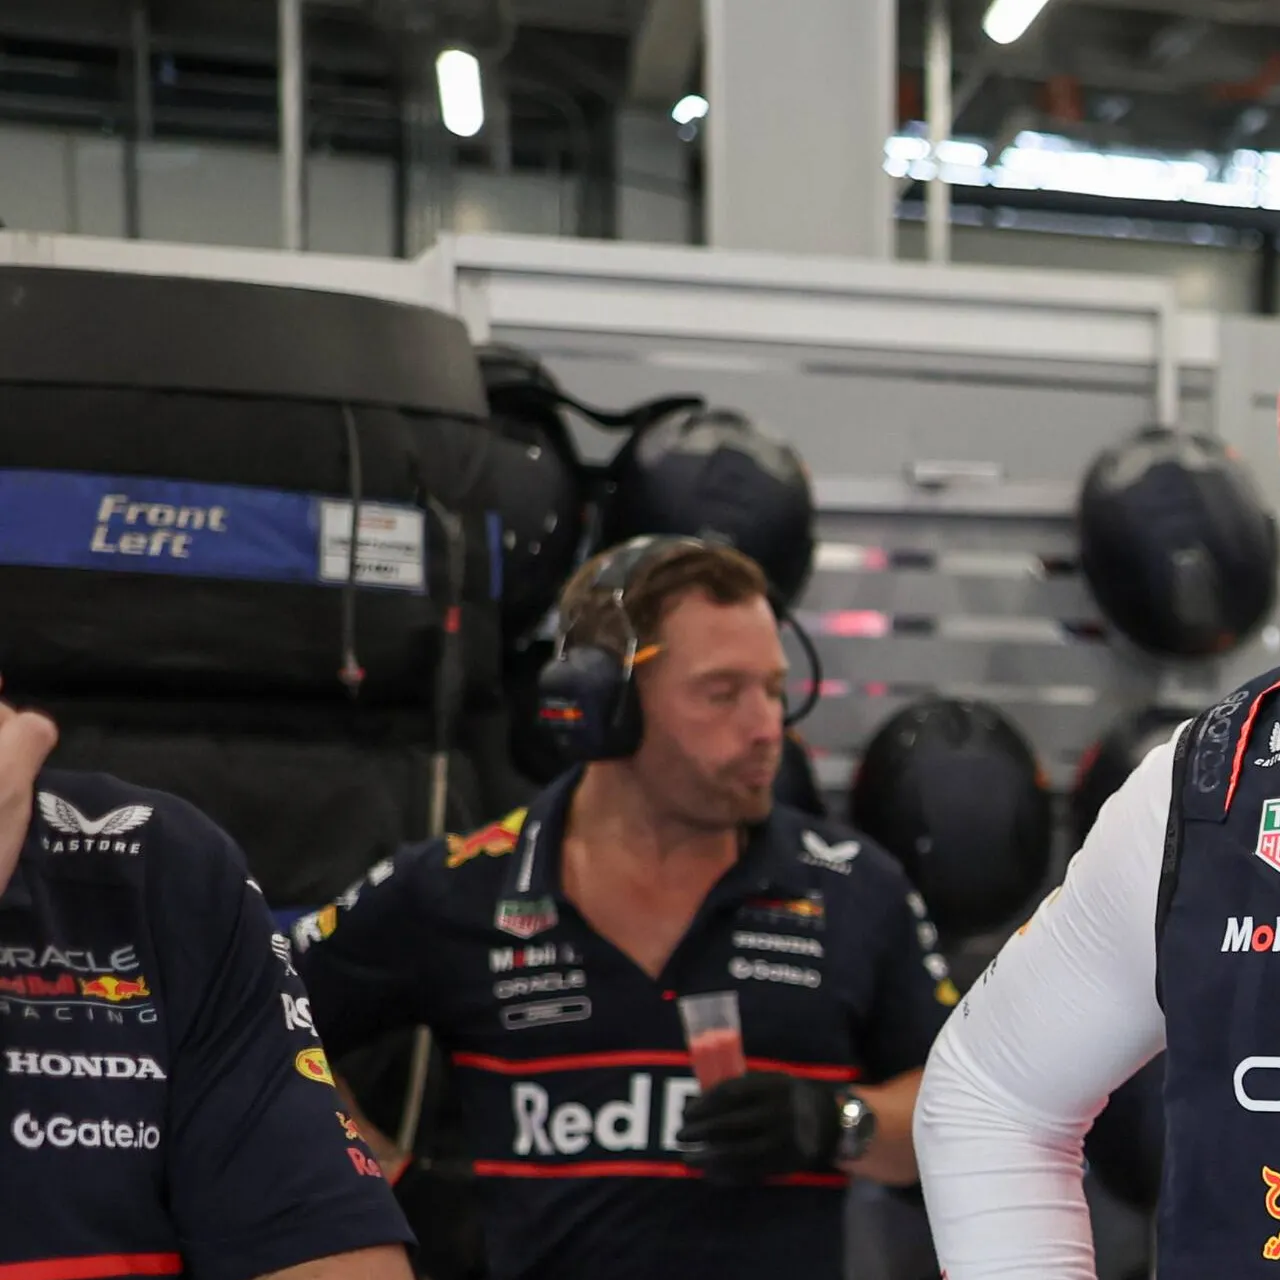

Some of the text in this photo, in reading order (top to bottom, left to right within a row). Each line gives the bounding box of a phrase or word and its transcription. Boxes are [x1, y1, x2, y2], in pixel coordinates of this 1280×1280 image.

[97, 494, 228, 532] Front
[90, 525, 193, 558] Left
[6, 1051, 167, 1080] HONDA
[512, 1072, 651, 1156] Red
[48, 1116, 161, 1150] Gate.io
